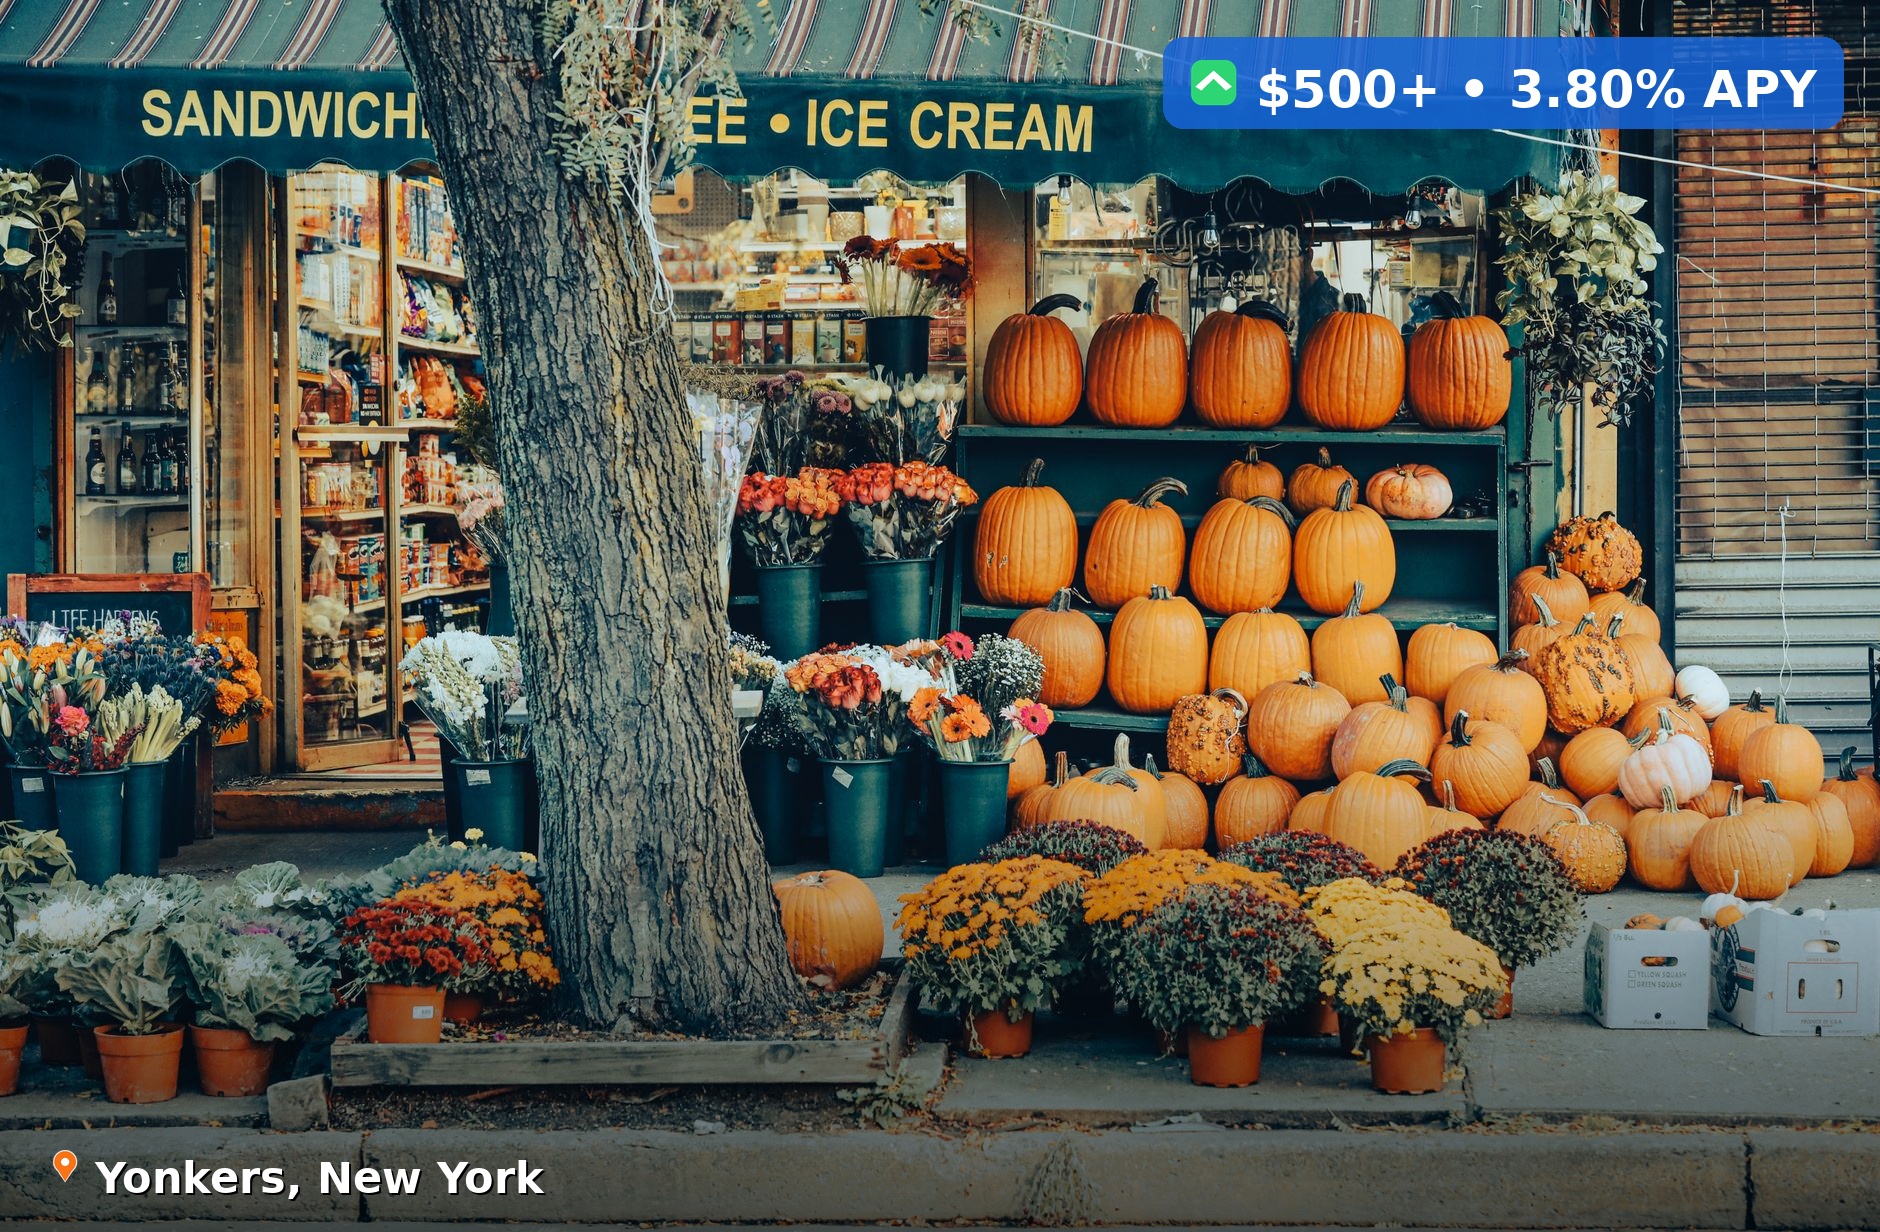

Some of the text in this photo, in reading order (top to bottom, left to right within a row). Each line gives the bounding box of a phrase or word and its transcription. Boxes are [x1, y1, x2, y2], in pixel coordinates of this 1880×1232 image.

[142, 89, 430, 139] SANDWICH
[807, 99, 888, 147] ICE
[910, 101, 1094, 152] CREAM
[94, 608, 161, 631] HANS
[1637, 970, 1660, 978] YELLOW
